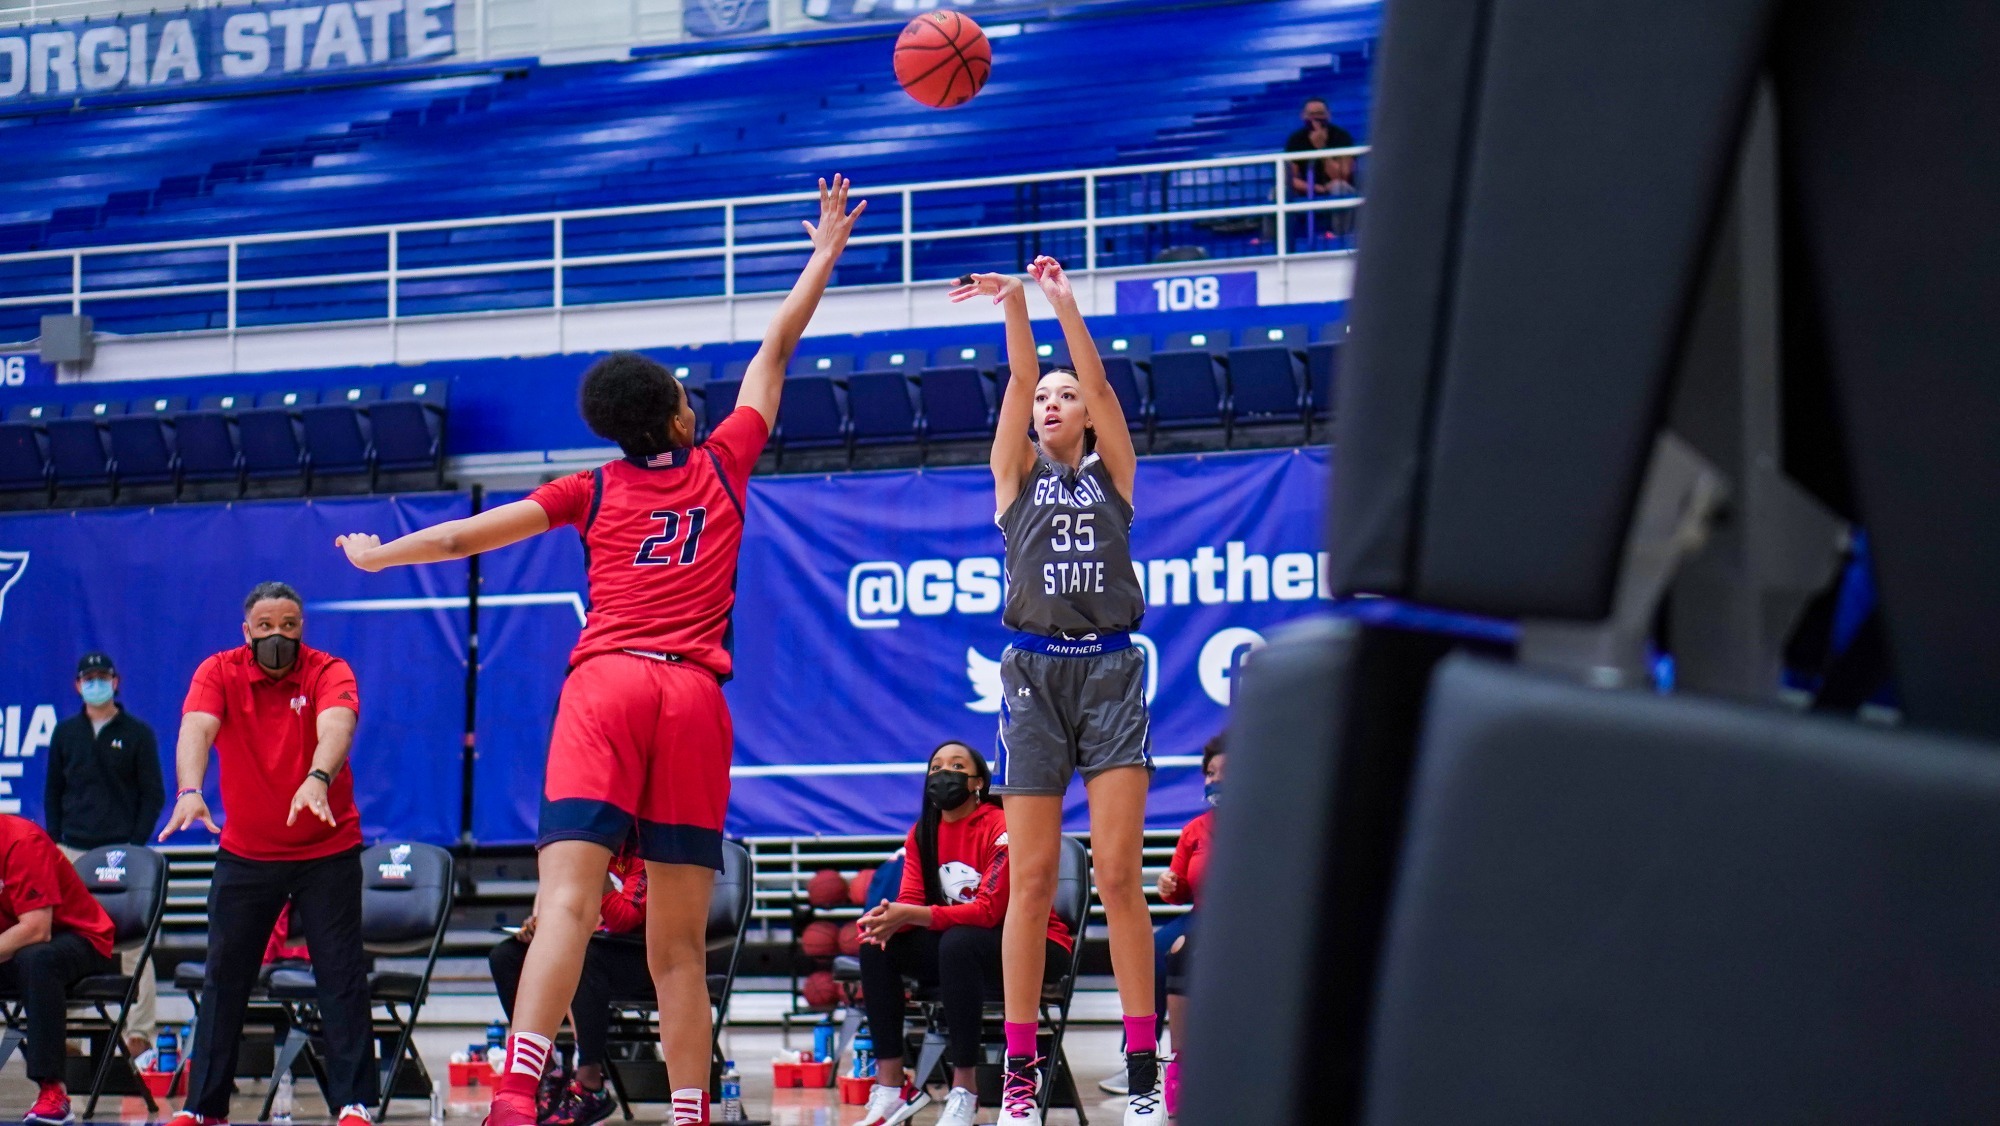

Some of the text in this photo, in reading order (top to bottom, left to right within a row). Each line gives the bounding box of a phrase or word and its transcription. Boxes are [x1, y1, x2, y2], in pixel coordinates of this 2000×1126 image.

[222, 0, 453, 78] STATE
[1152, 276, 1220, 312] 108
[633, 506, 707, 566] 21
[1051, 513, 1096, 552] 35
[1043, 561, 1105, 595] STATE
[1046, 643, 1103, 655] PANTHERS
